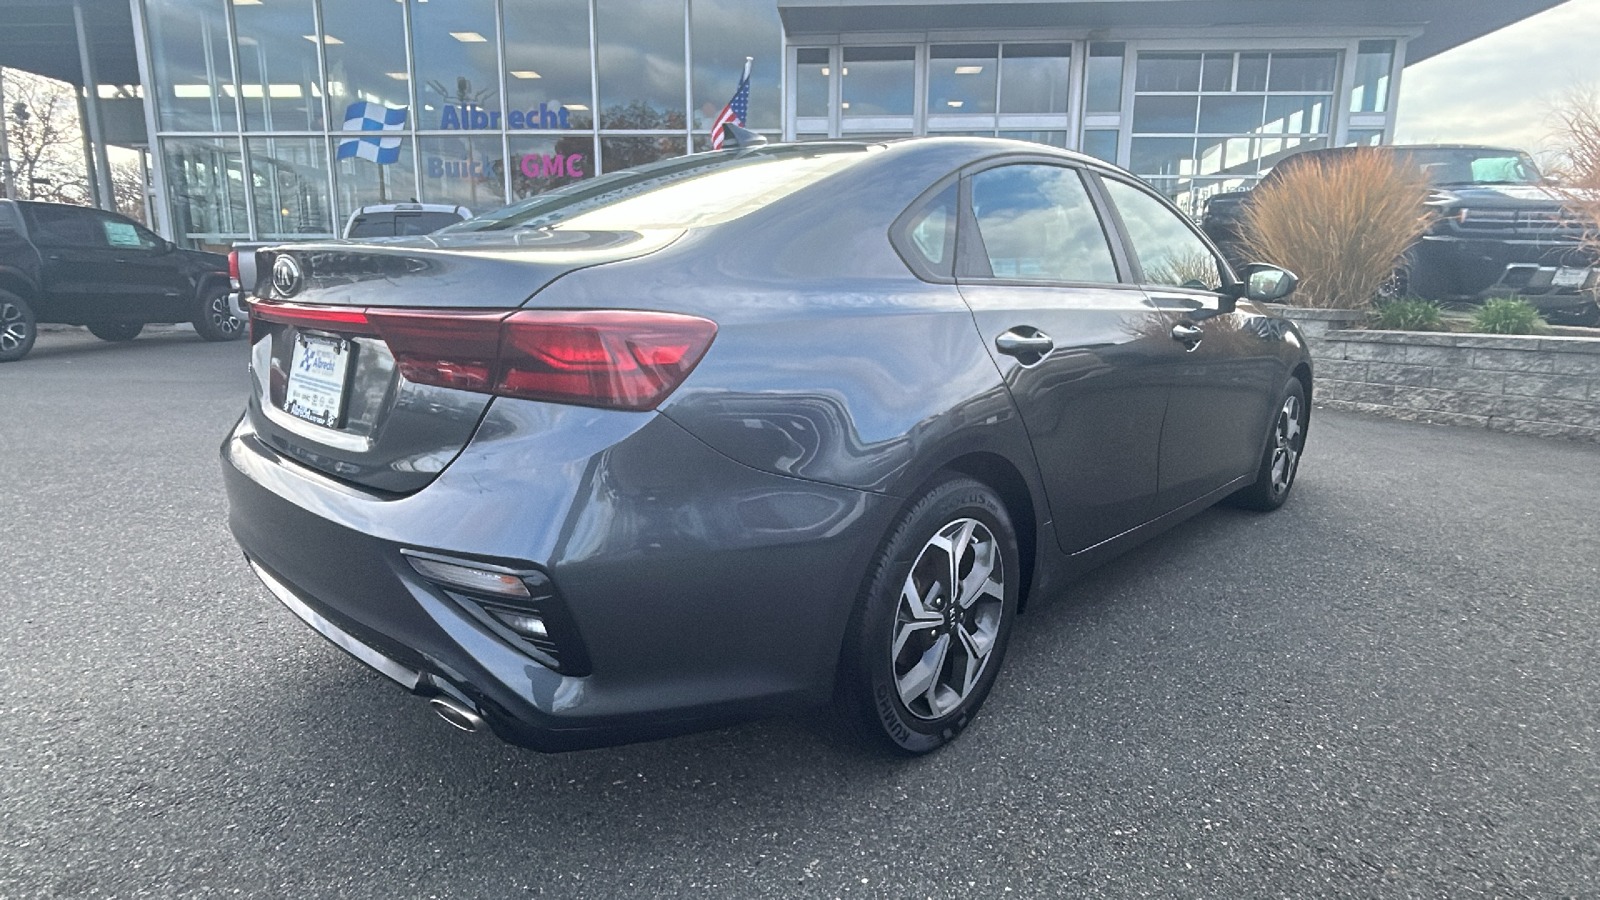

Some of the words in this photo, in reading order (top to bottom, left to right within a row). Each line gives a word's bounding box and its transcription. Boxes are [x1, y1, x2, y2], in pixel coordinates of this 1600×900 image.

[440, 103, 571, 130] Albrecht
[427, 153, 496, 179] Buick
[521, 153, 584, 178] GMC
[876, 684, 911, 743] KUMHO
